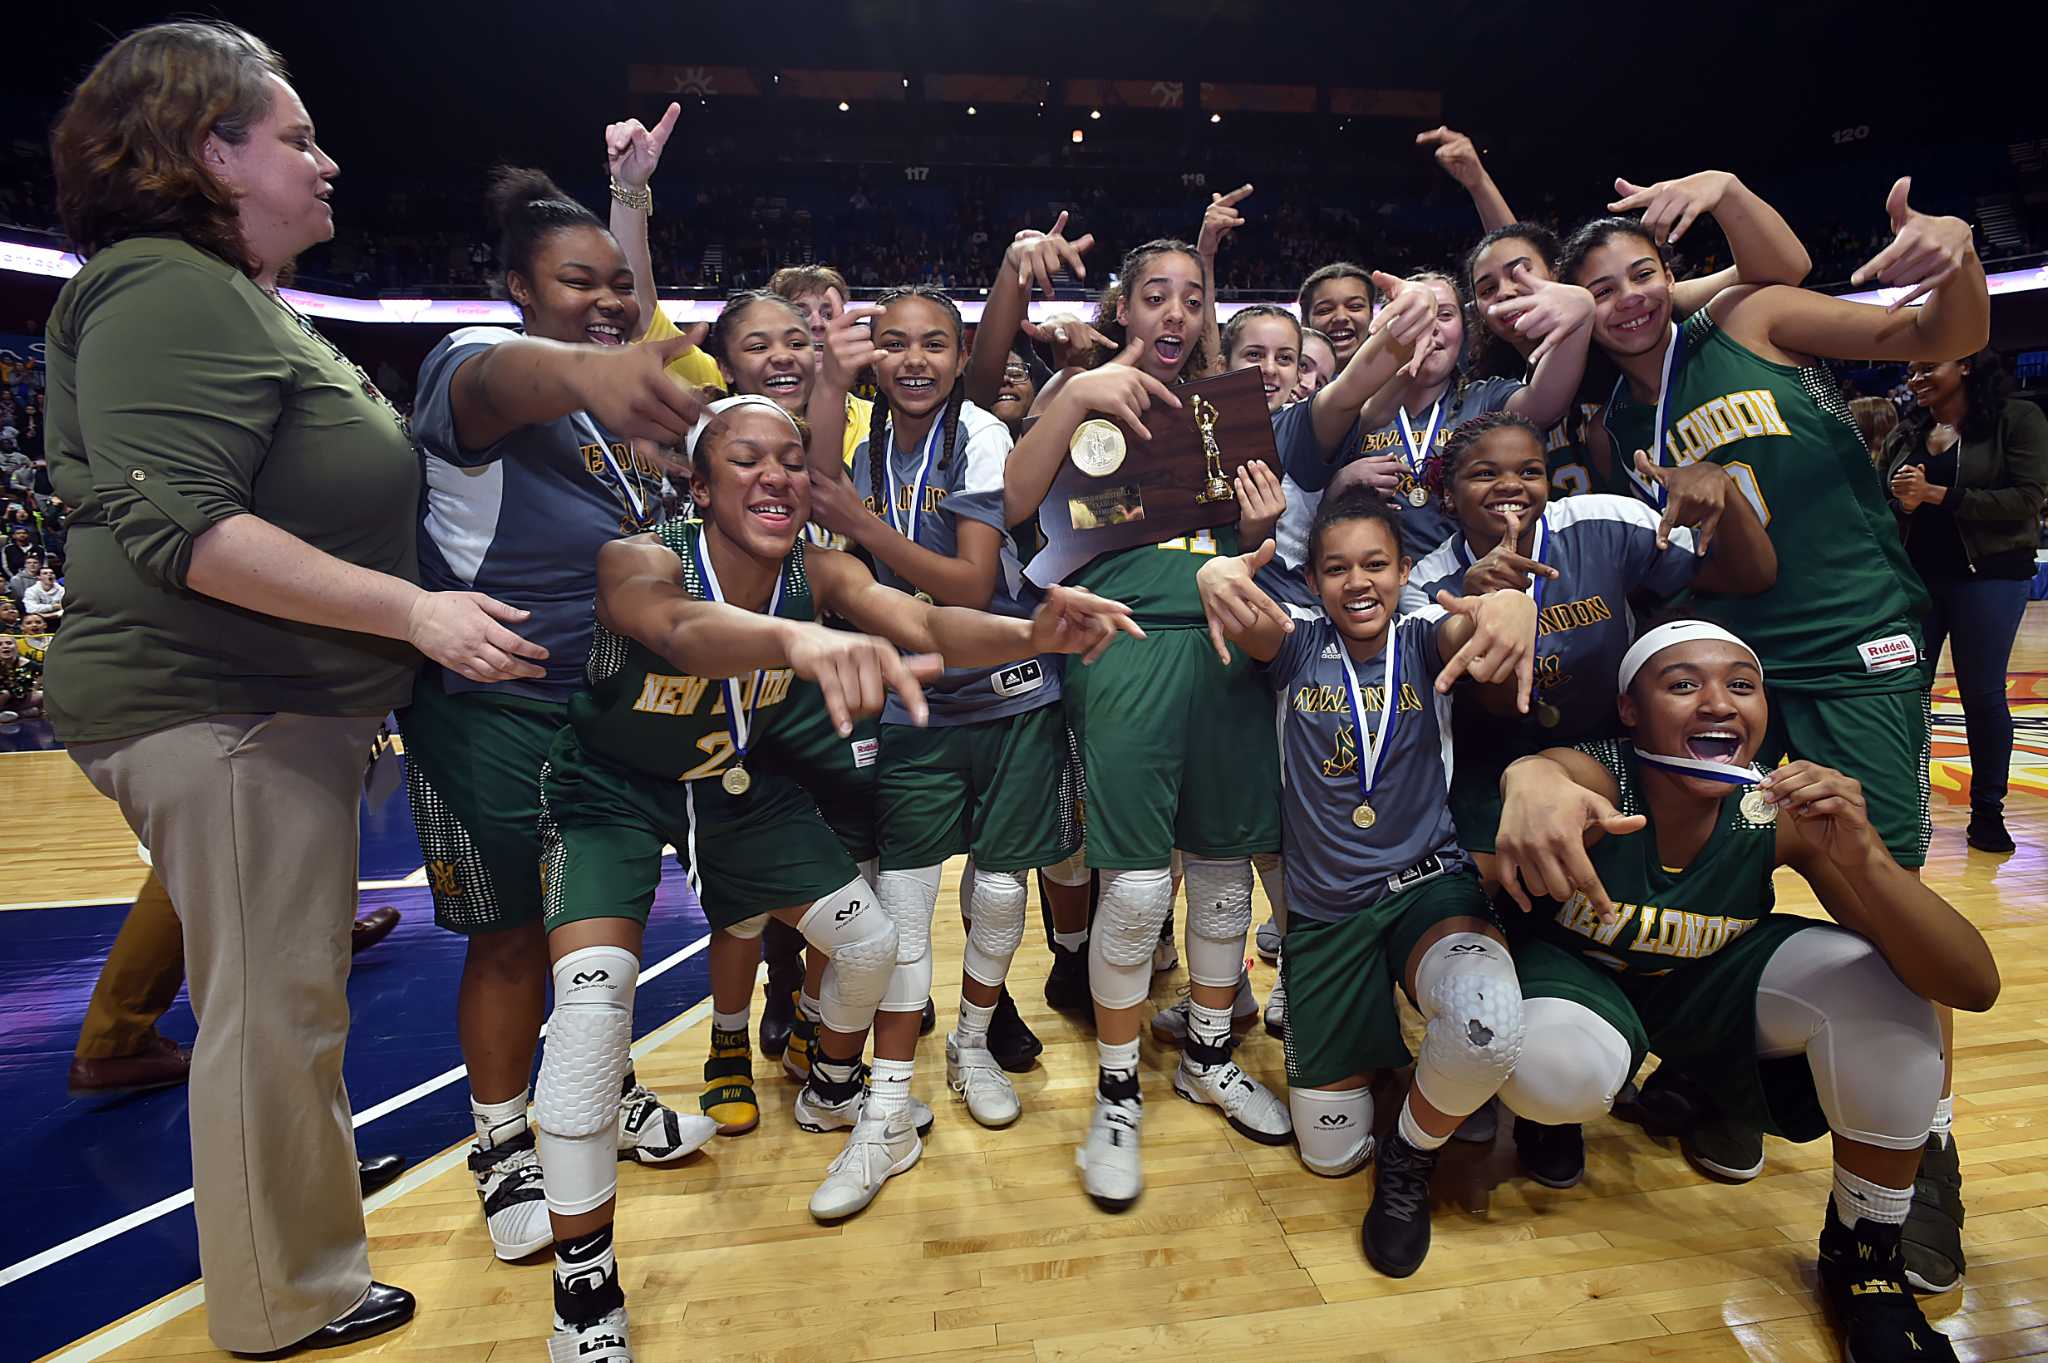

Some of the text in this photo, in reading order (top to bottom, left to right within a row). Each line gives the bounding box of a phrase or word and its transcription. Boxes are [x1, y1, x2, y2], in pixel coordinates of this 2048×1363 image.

[1832, 125, 1870, 144] 120
[904, 167, 929, 180] 117
[1666, 389, 1792, 468] LONDON
[1867, 640, 1909, 656] Riddell
[632, 672, 709, 715] NEW
[677, 730, 738, 781] 2
[722, 1088, 742, 1099] WIN
